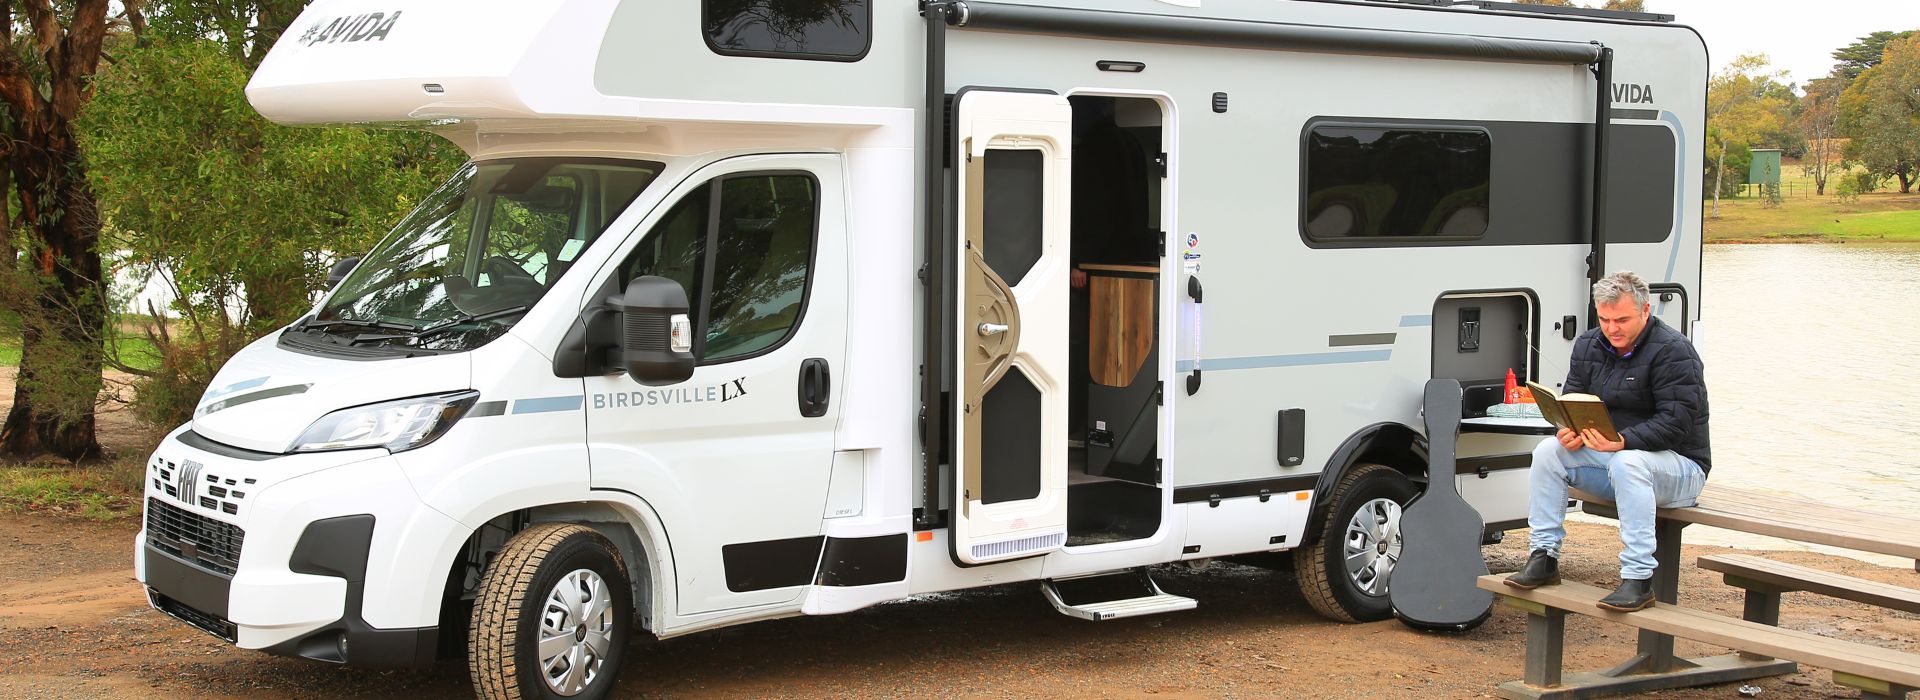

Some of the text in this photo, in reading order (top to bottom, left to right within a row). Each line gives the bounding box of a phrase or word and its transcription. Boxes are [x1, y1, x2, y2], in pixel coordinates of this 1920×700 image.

[308, 11, 402, 47] AVIDA
[1610, 83, 1653, 104] VIDA
[593, 376, 748, 409] BIRDSVILLE LX
[177, 459, 204, 505] FIAT
